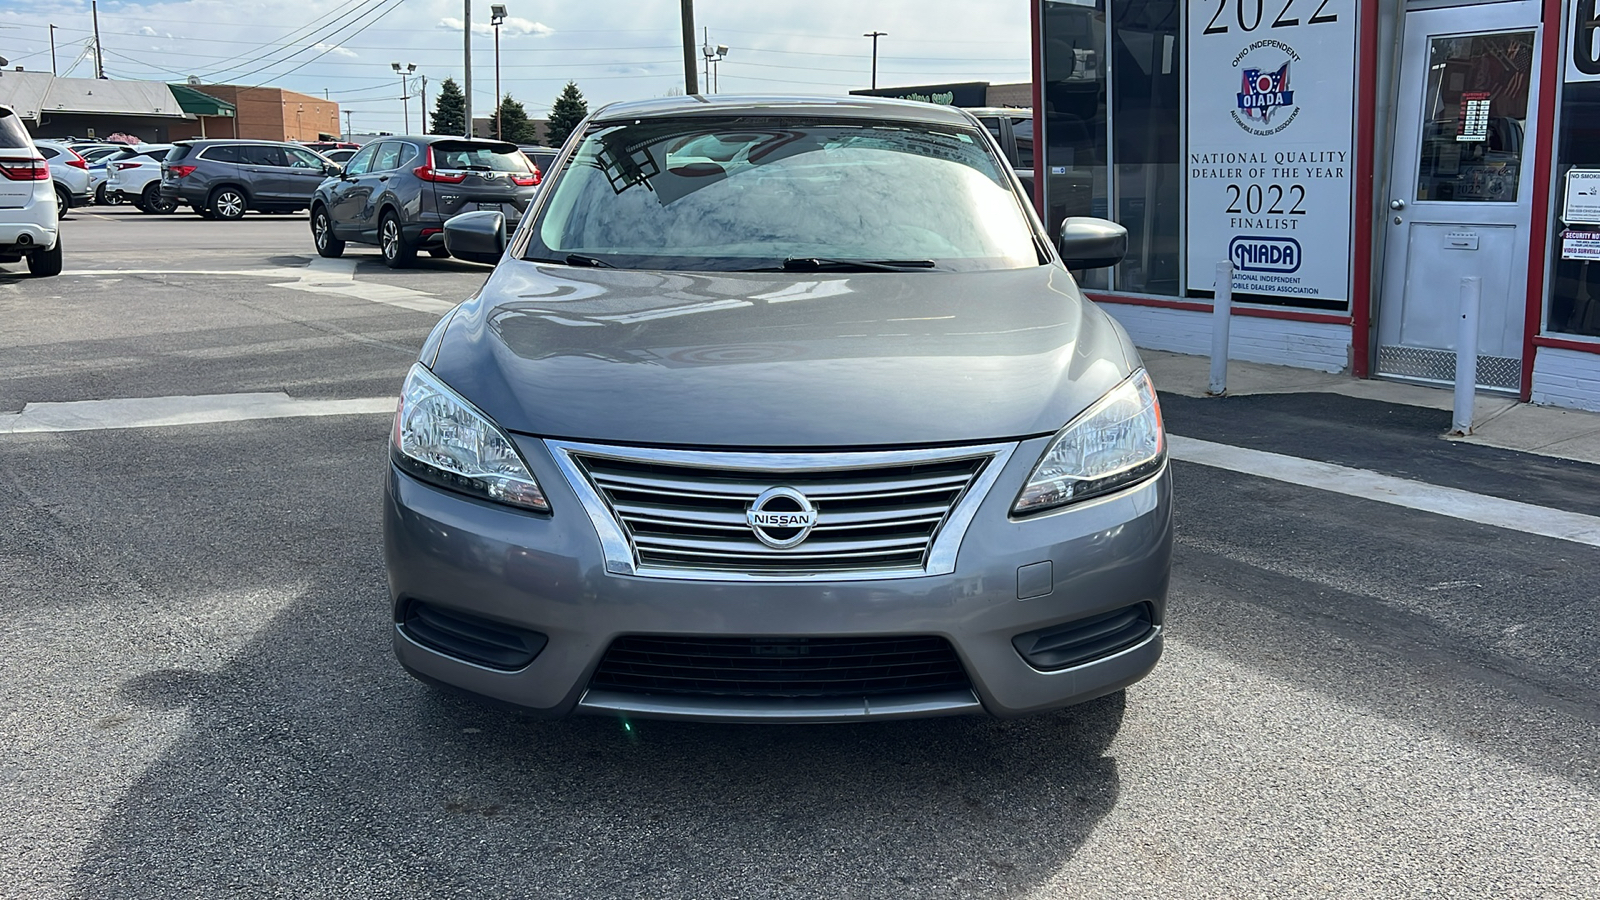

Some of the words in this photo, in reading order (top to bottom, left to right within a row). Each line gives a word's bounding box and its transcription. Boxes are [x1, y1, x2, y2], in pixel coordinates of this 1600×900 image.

[1231, 48, 1249, 68] OHIO
[1249, 39, 1301, 63] INDEPENDENT
[1243, 92, 1284, 107] OIADA
[1230, 109, 1253, 134] AUTOMOBILE
[1253, 128, 1274, 136] DEALERS
[1274, 106, 1301, 134] ASSOCIATION
[1191, 152, 1268, 164] NATIONAL
[1274, 151, 1347, 165] QUALITY
[1192, 168, 1243, 179] DEALER
[1248, 168, 1266, 178] OF
[1272, 168, 1299, 178] THE
[1306, 168, 1344, 178] YEAR
[1225, 184, 1307, 215] 2022
[1230, 218, 1299, 230] FINALIST
[1234, 243, 1294, 266] NIADA
[1260, 275, 1301, 284] INDEPENDENT
[1250, 284, 1276, 292] DEALERS
[1276, 286, 1319, 295] ASSOCIATION
[754, 514, 809, 524] NISSAN
